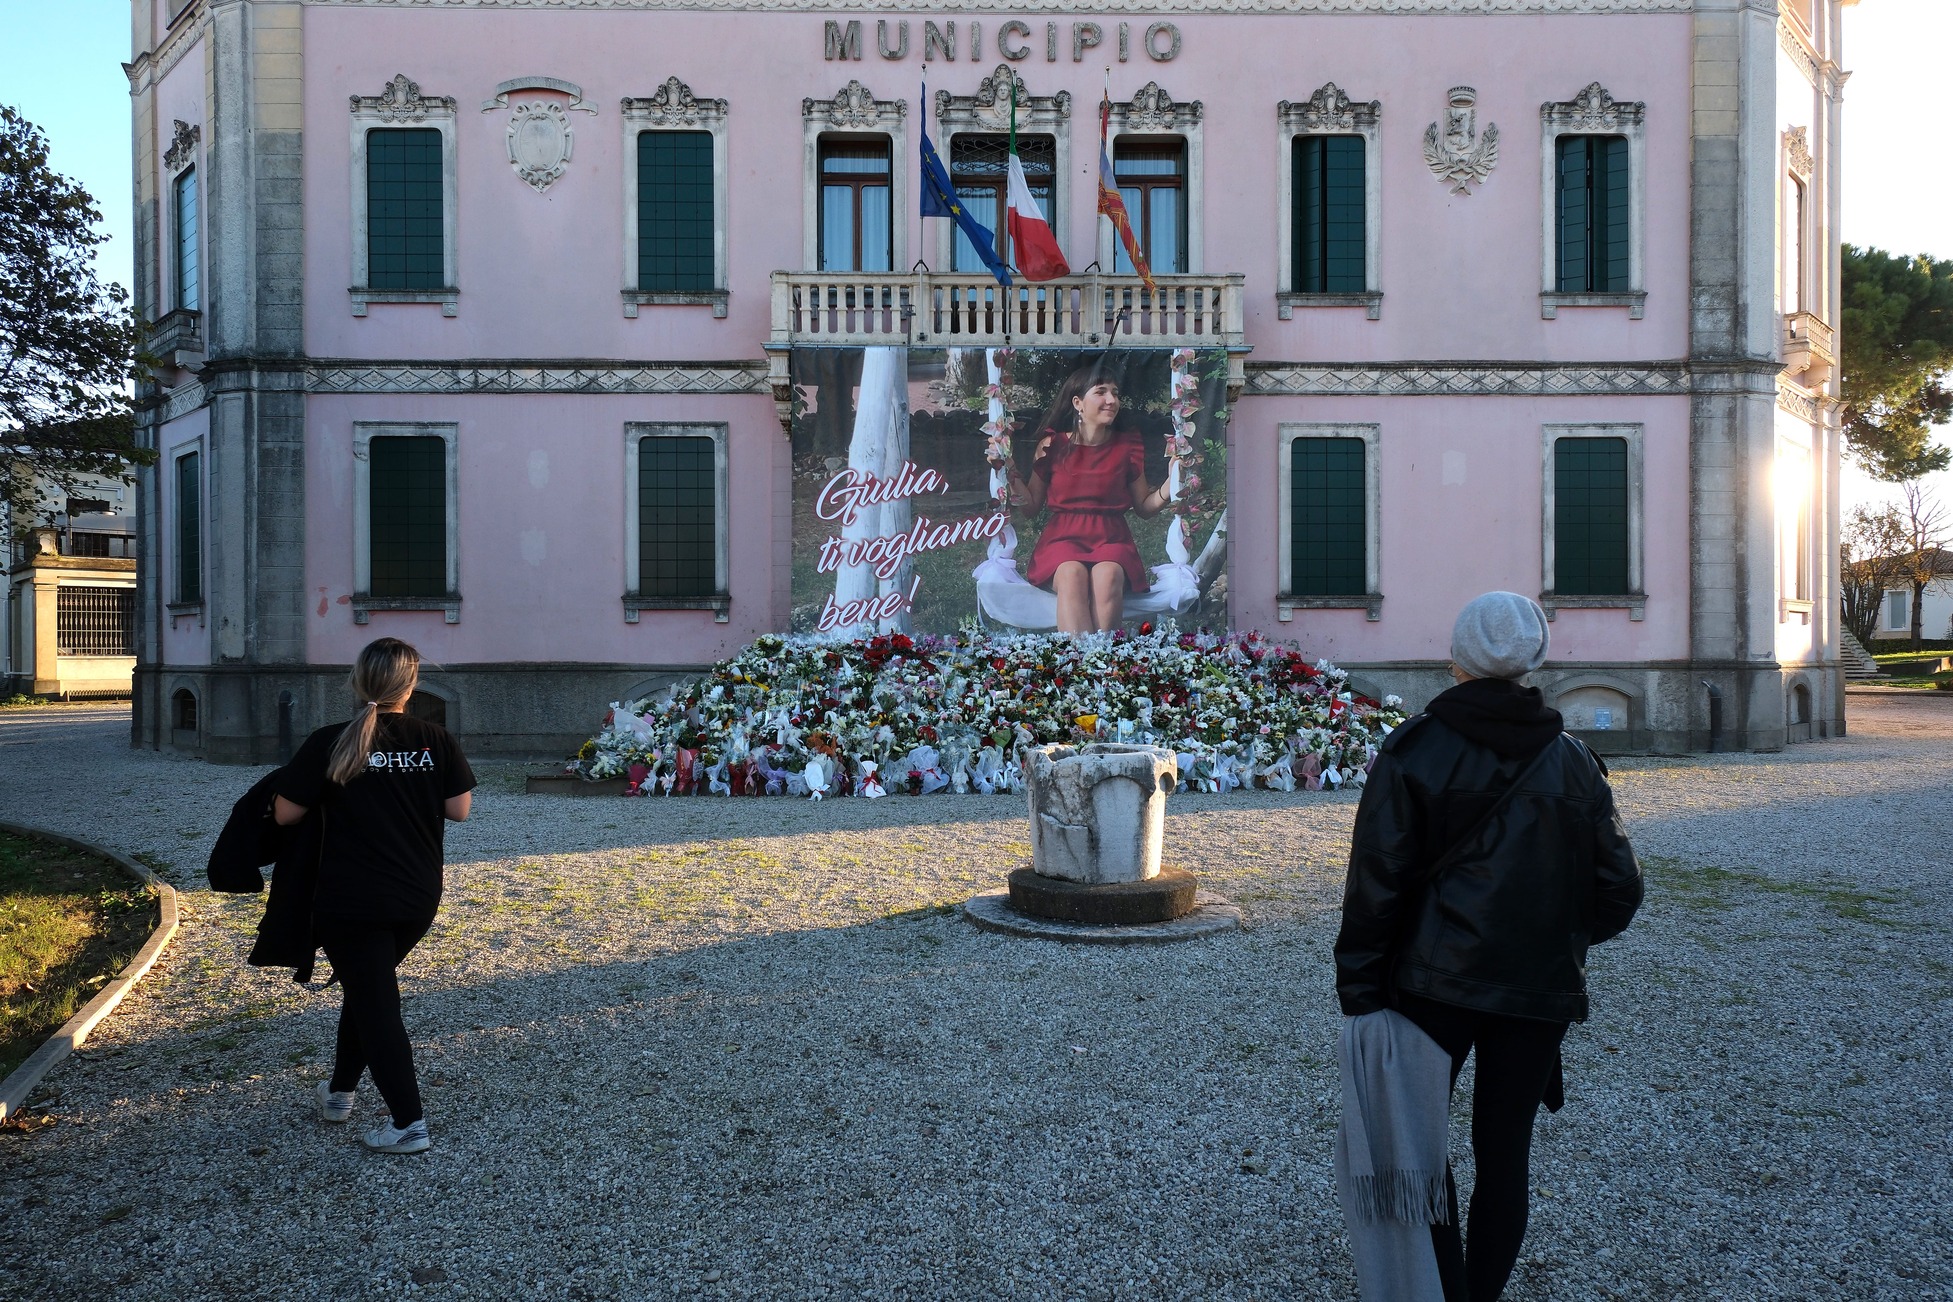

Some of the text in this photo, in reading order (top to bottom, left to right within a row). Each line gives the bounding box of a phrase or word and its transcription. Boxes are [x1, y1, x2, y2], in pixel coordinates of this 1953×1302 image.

[824, 19, 1182, 62] MUNICIPIO
[816, 460, 949, 526] Giulia,
[816, 512, 1011, 579] ti vogliamo
[817, 574, 921, 632] bene!
